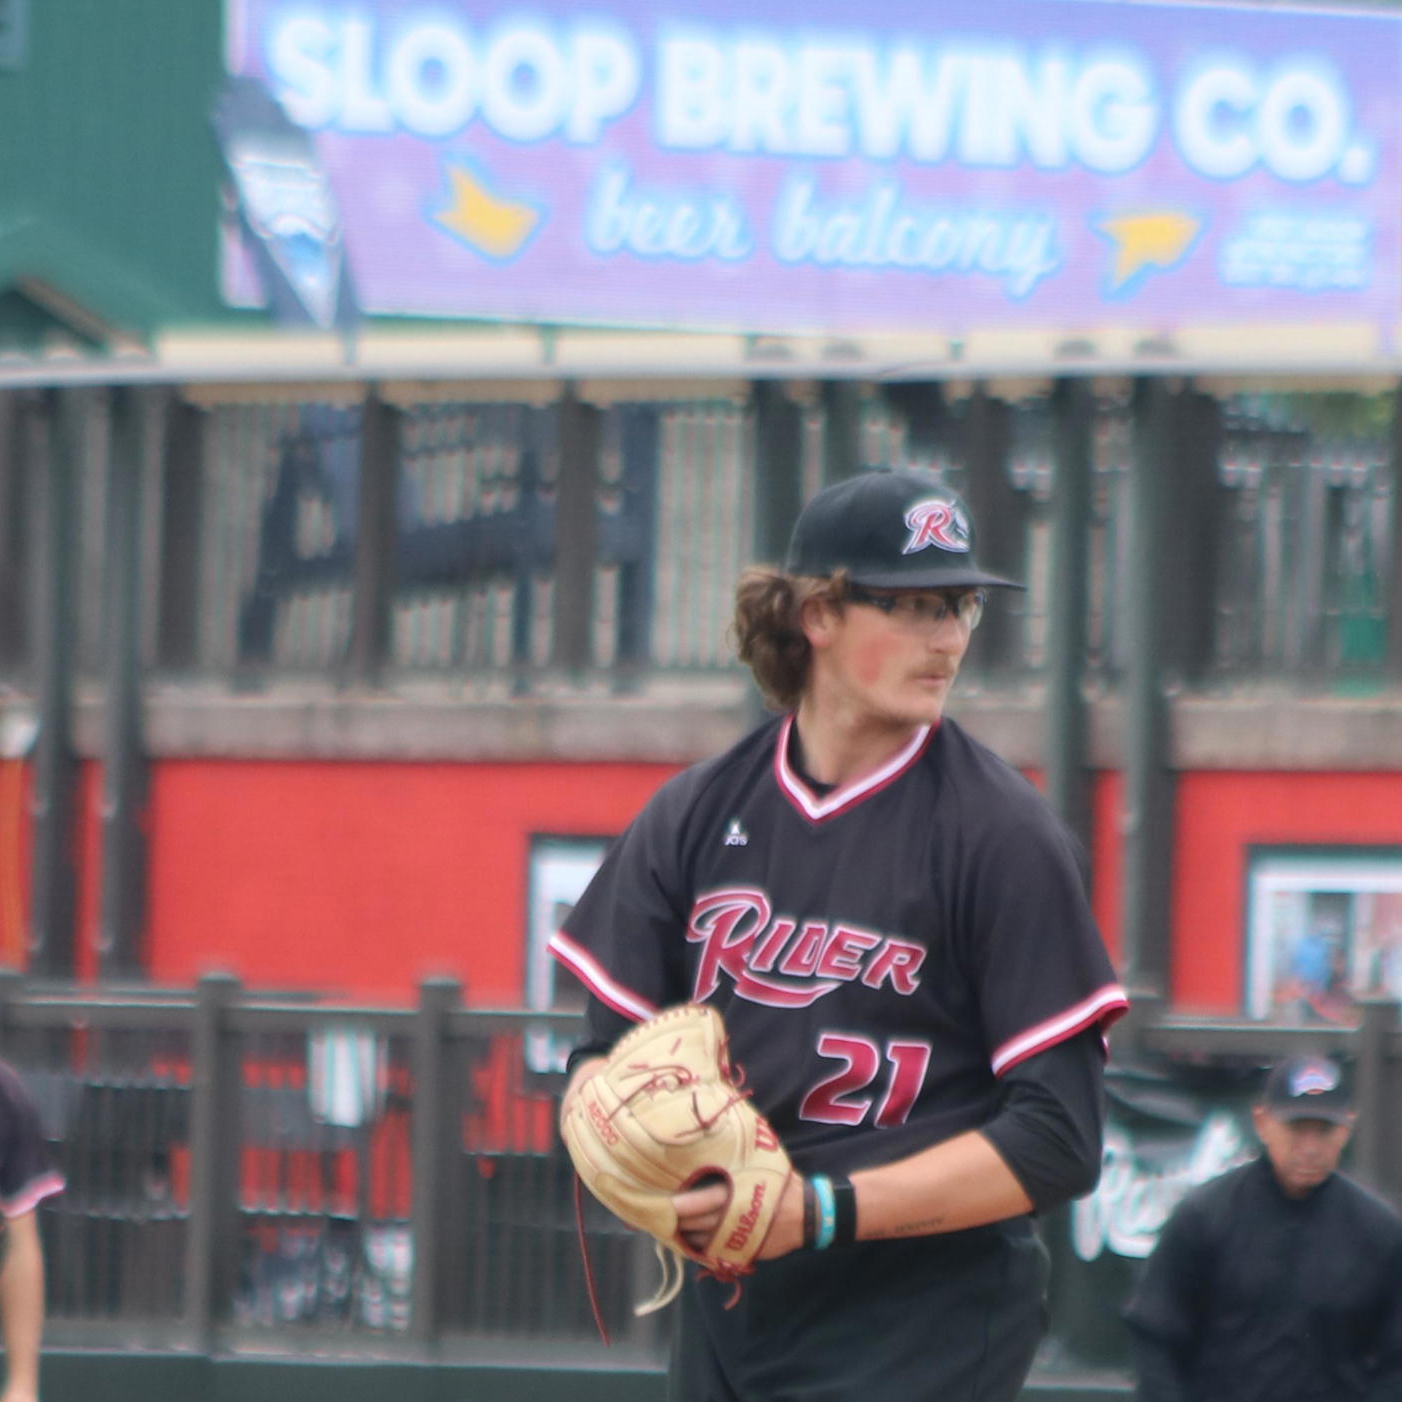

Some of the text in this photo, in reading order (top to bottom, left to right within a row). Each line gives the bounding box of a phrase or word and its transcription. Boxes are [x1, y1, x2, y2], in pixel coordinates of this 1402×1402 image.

[268, 14, 1375, 185] SLOOP BREWING CO.
[589, 166, 1060, 299] beer balcony
[901, 499, 970, 554] R
[686, 887, 927, 1008] RIDER
[799, 1032, 933, 1129] 21
